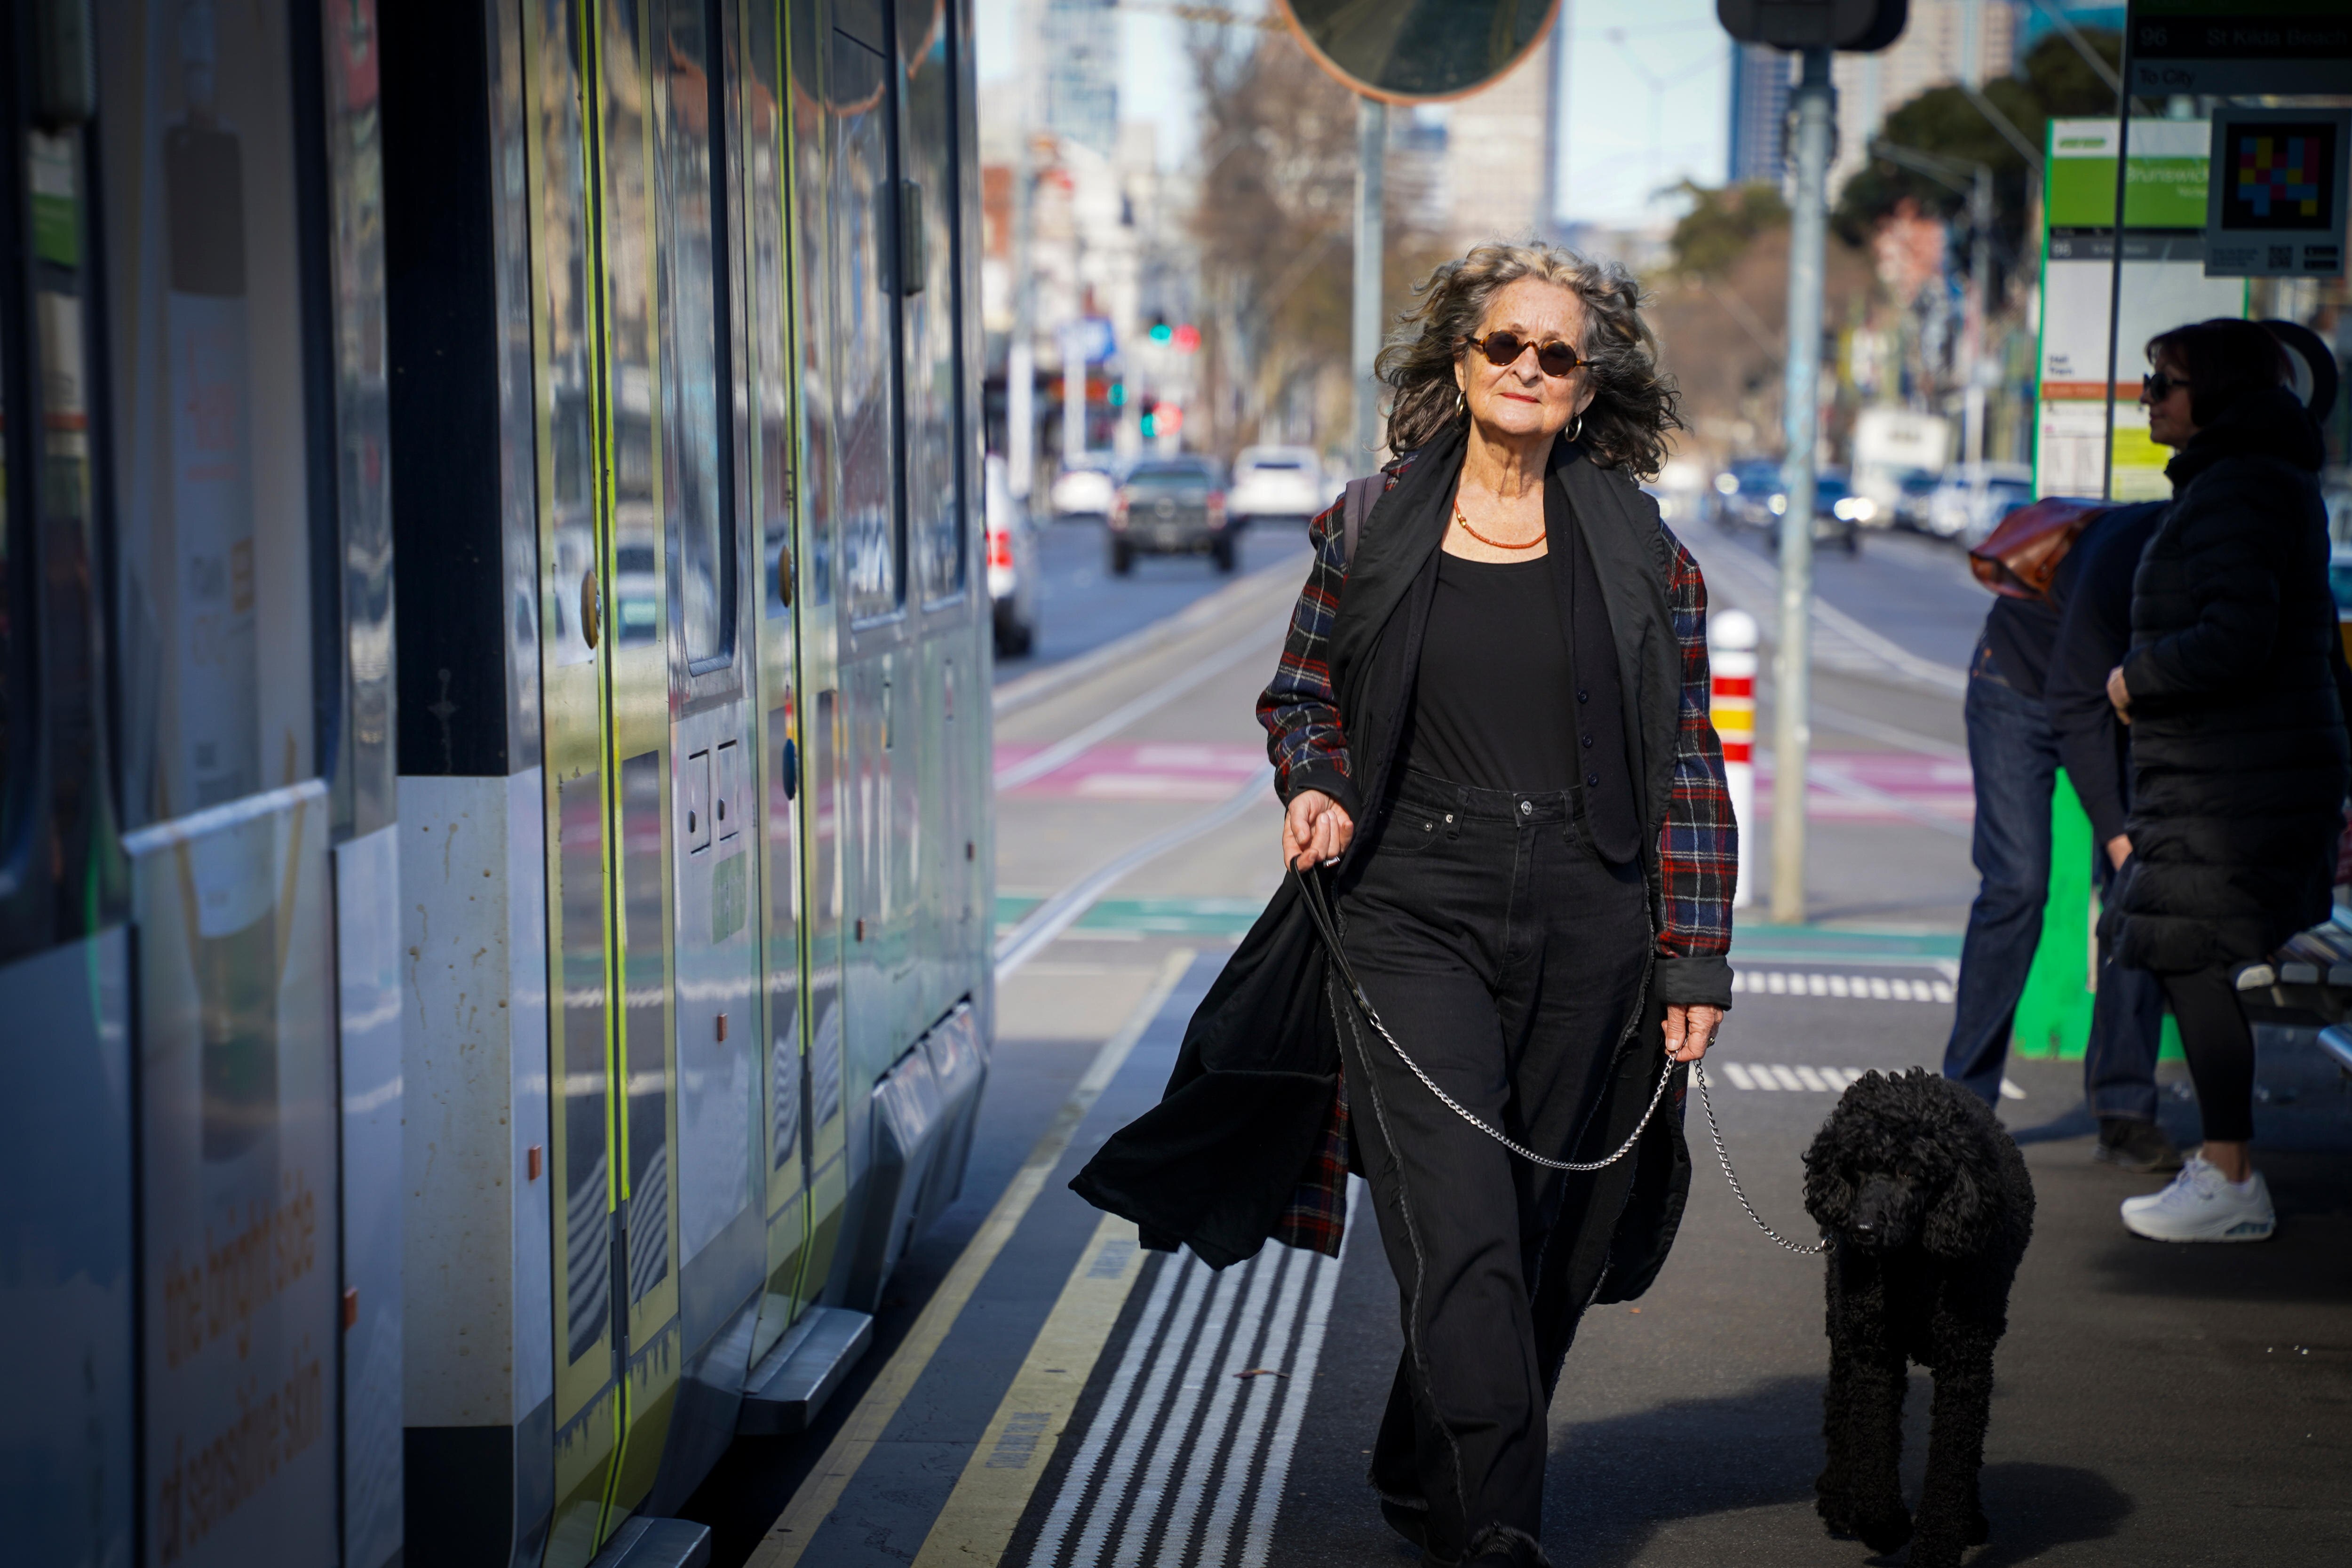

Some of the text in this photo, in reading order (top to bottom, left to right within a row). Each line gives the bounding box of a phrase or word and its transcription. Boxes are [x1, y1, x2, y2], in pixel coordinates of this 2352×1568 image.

[2140, 25, 2168, 47] 96
[2206, 27, 2227, 47] St
[2139, 67, 2196, 88] To City
